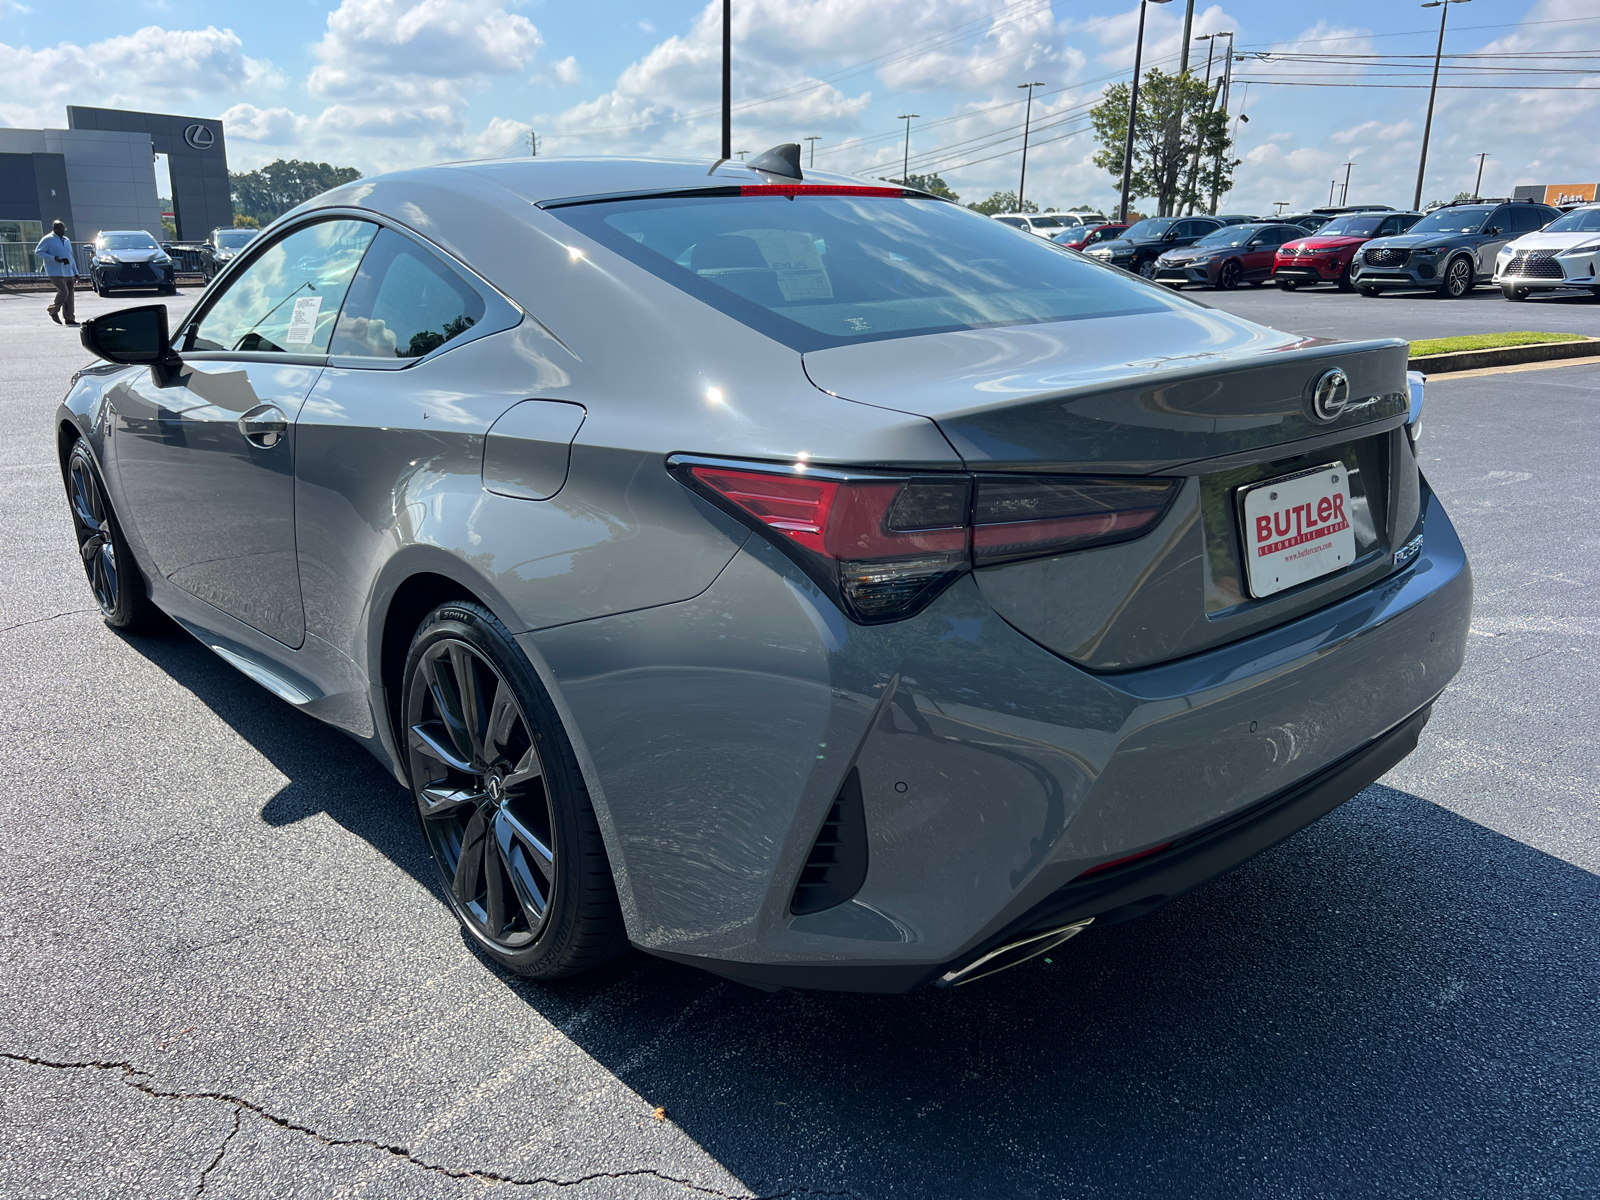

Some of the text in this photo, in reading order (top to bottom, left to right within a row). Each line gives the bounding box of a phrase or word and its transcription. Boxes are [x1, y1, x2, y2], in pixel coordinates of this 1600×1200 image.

[772, 261, 808, 270] EXUS
[1258, 520, 1348, 556] AUTOMOTIVE GROUP
[1285, 542, 1332, 563] www.butlercars.com
